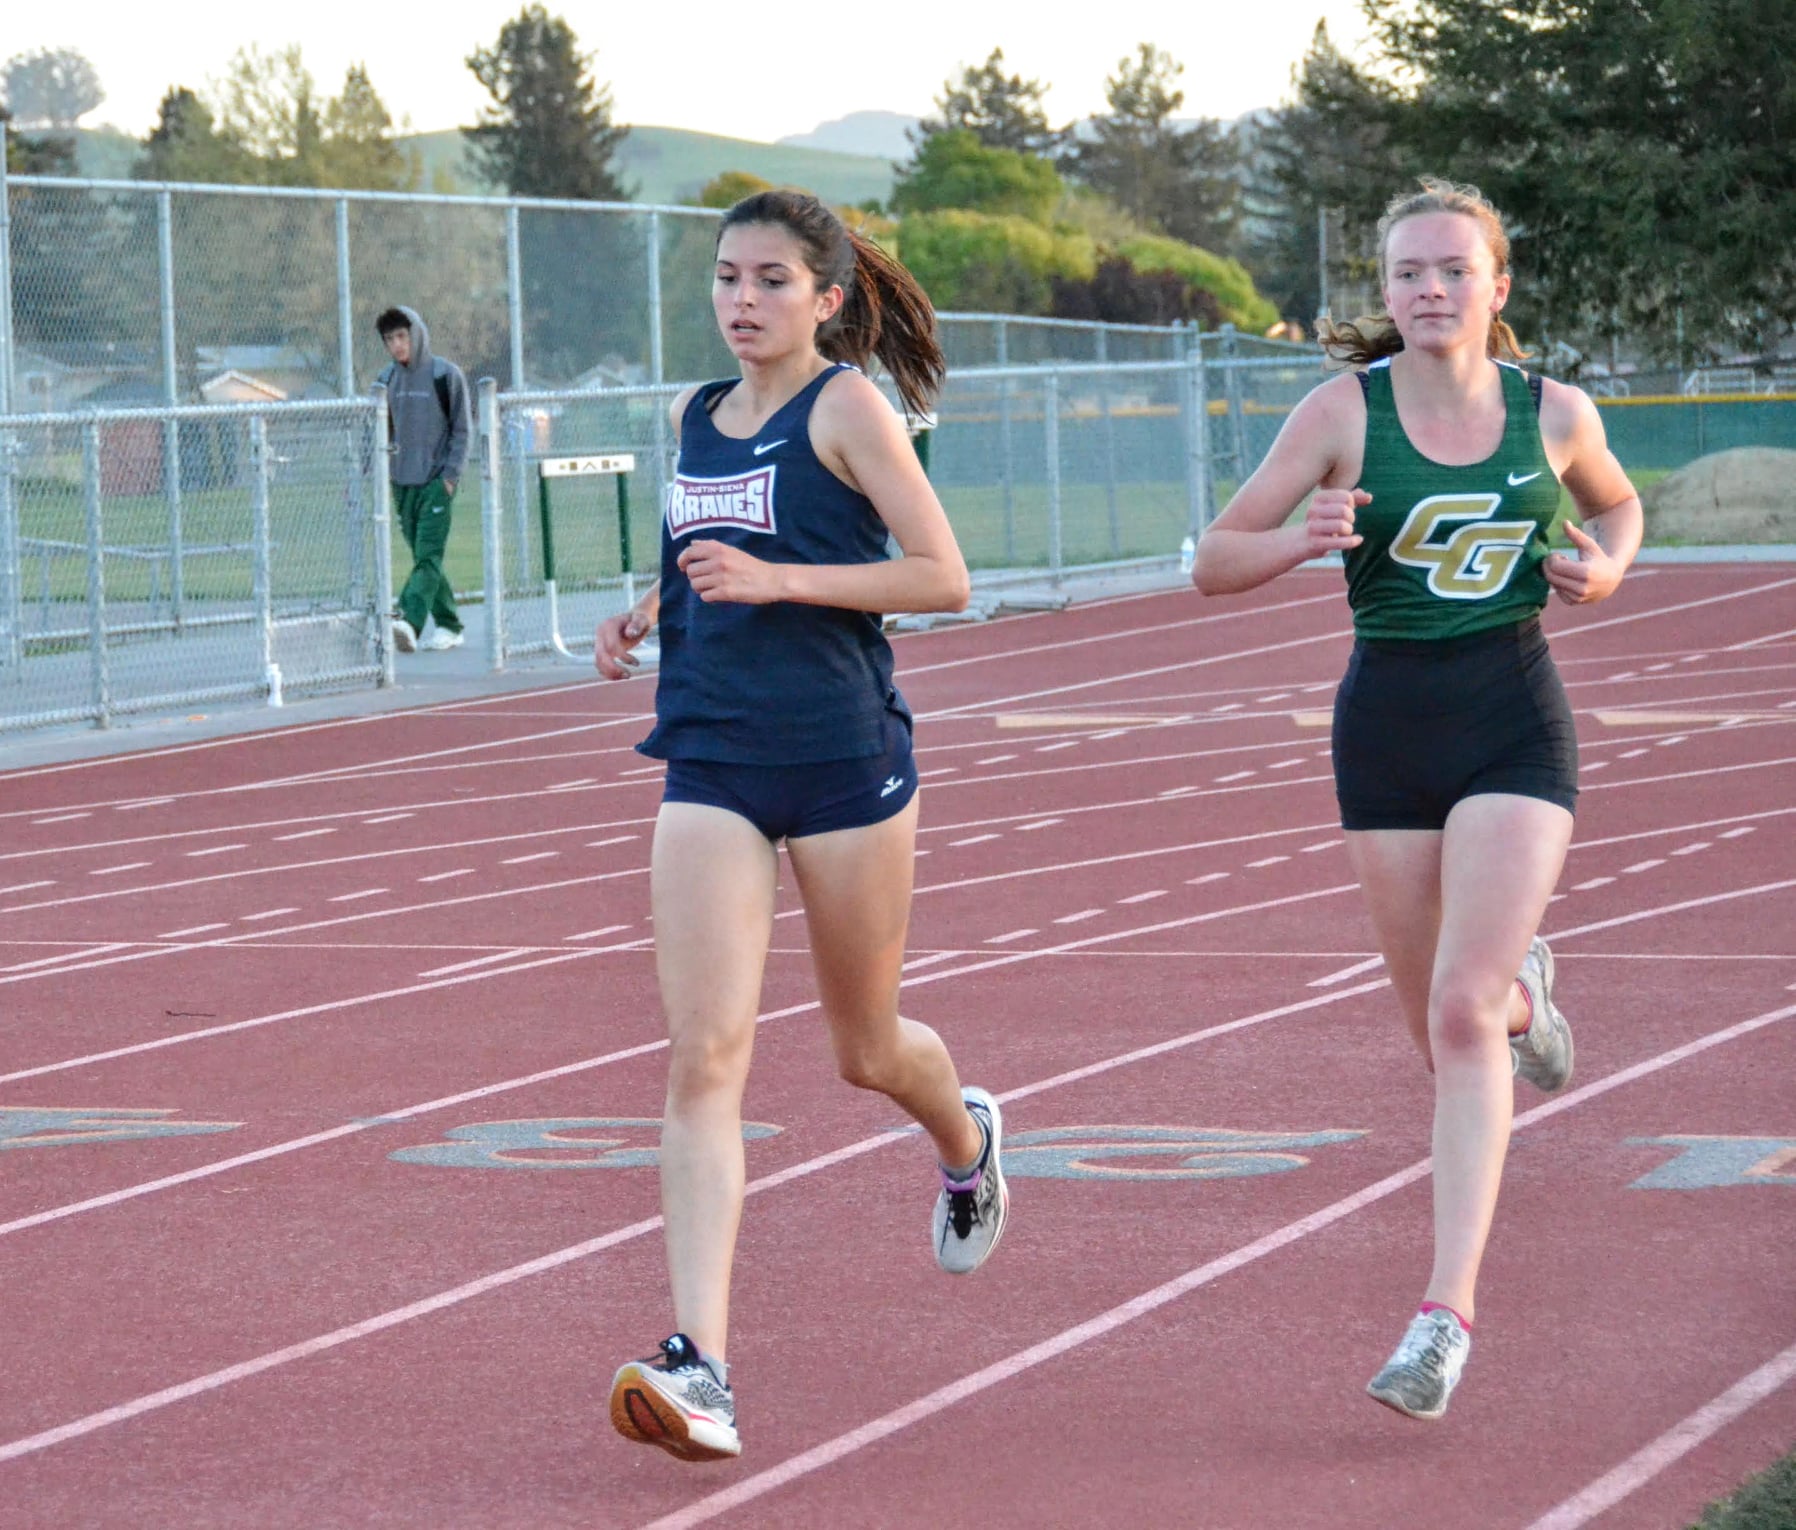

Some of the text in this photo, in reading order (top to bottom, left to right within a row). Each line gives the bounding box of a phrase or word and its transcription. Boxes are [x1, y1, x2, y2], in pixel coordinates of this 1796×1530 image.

[671, 478, 766, 528] BRAVES
[686, 483, 745, 494] JUSTIN-SIENA
[1389, 493, 1537, 599] CG
